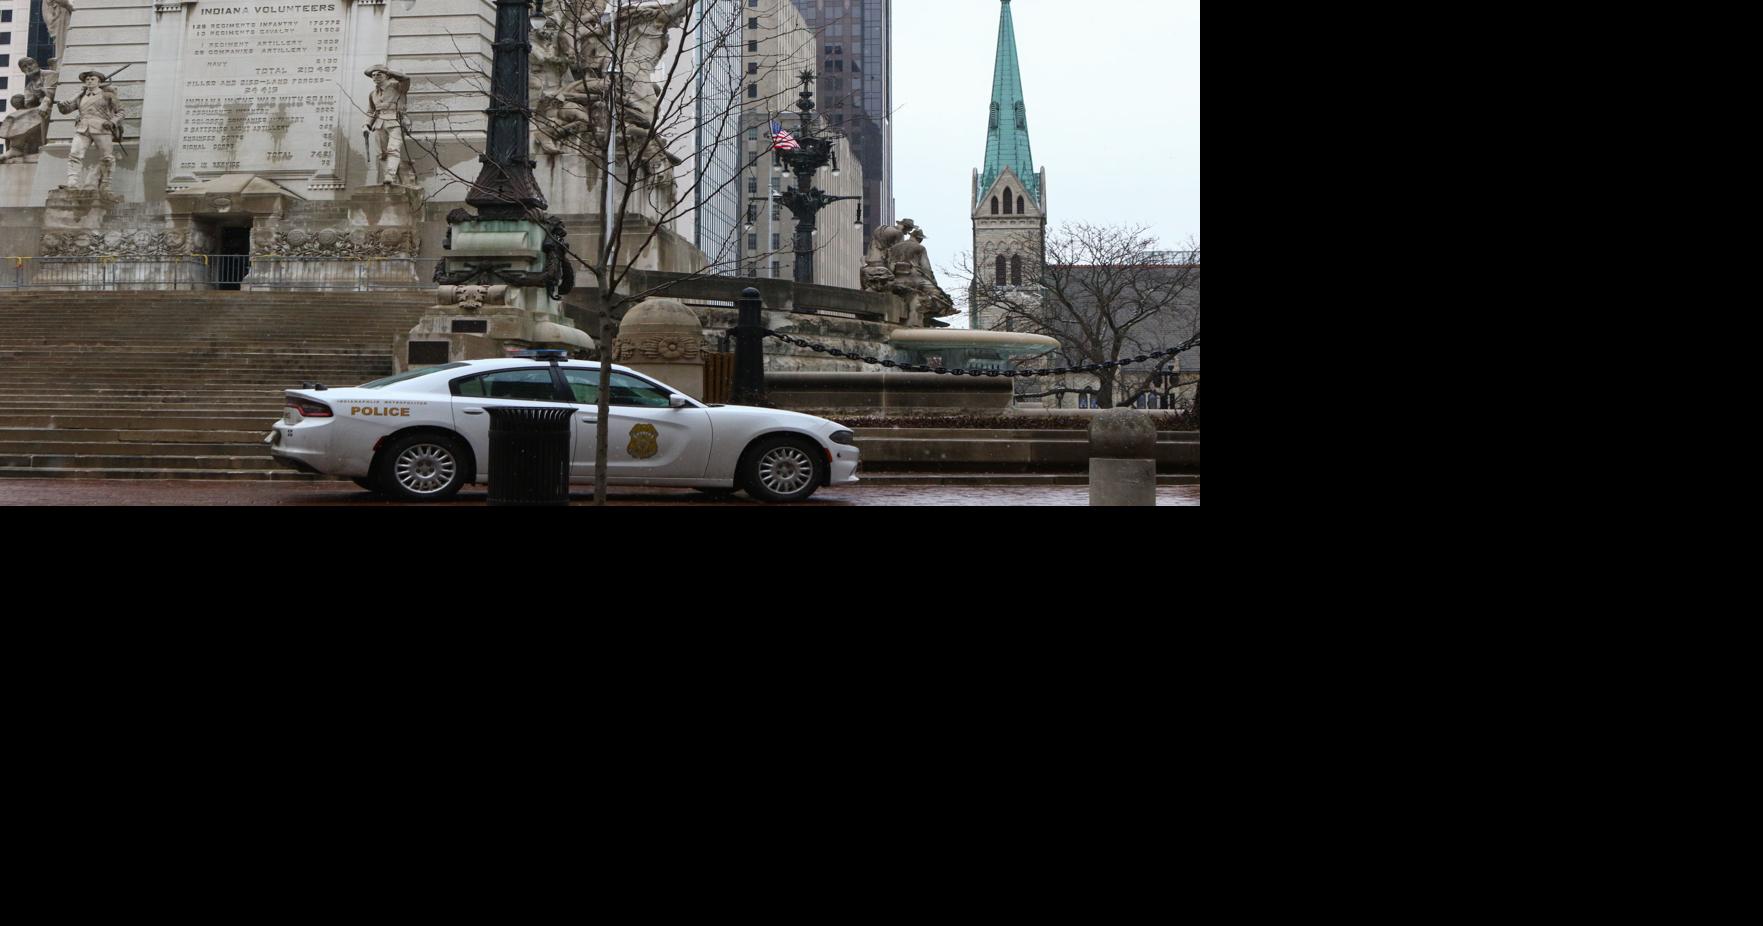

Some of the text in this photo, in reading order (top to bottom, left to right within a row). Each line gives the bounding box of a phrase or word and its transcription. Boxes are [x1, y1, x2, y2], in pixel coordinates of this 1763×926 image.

[201, 4, 336, 15] INDIANA VOLUNTEERS
[255, 66, 288, 75] TOTAL
[267, 151, 294, 160] TOTAL
[351, 406, 411, 417] POLICE
